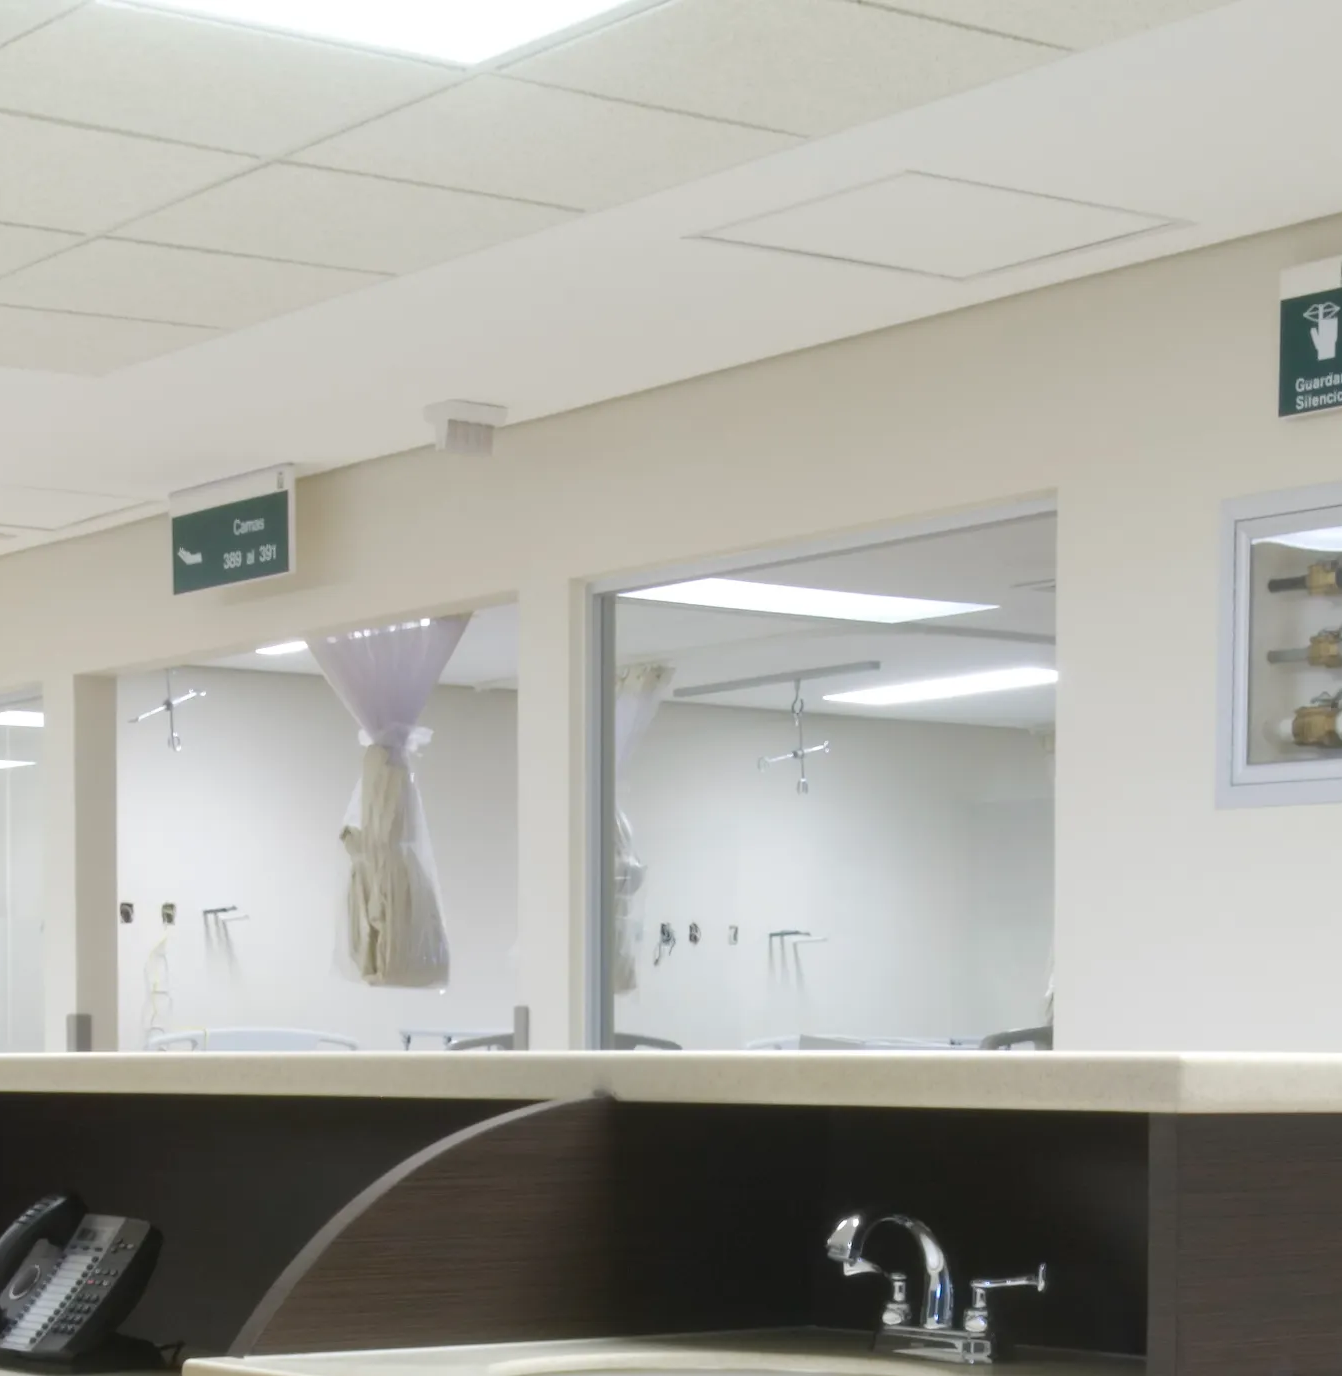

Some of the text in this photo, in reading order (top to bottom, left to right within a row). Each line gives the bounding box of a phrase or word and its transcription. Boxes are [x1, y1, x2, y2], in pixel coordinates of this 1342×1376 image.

[233, 517, 265, 536] Camas
[223, 544, 277, 569] 389 al 391
